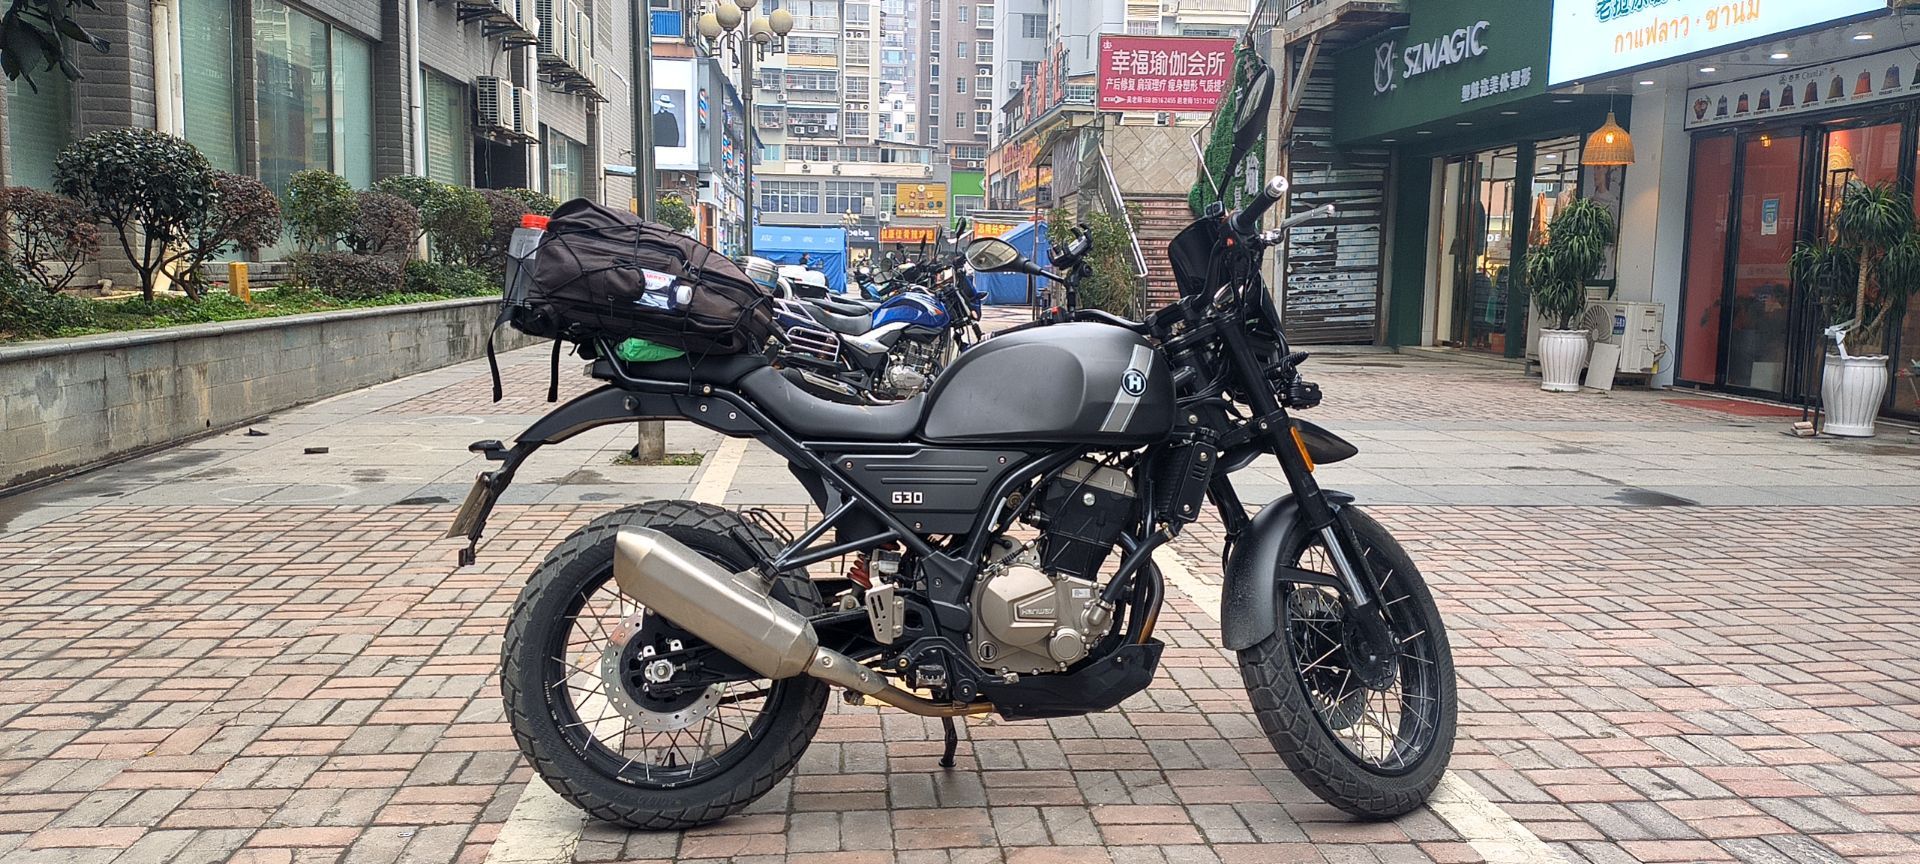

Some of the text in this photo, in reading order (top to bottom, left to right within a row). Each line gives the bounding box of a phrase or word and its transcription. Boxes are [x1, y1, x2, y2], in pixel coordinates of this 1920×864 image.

[1596, 0, 1665, 20] 老挝
[1614, 15, 1689, 53] กาแฟลาว
[1402, 21, 1490, 79] SZMAGIC
[1111, 49, 1226, 76] 幸福瑜伽会所
[1105, 77, 1135, 90] 产后修复
[1200, 79, 1226, 93] 气质提
[892, 491, 923, 504] G30
